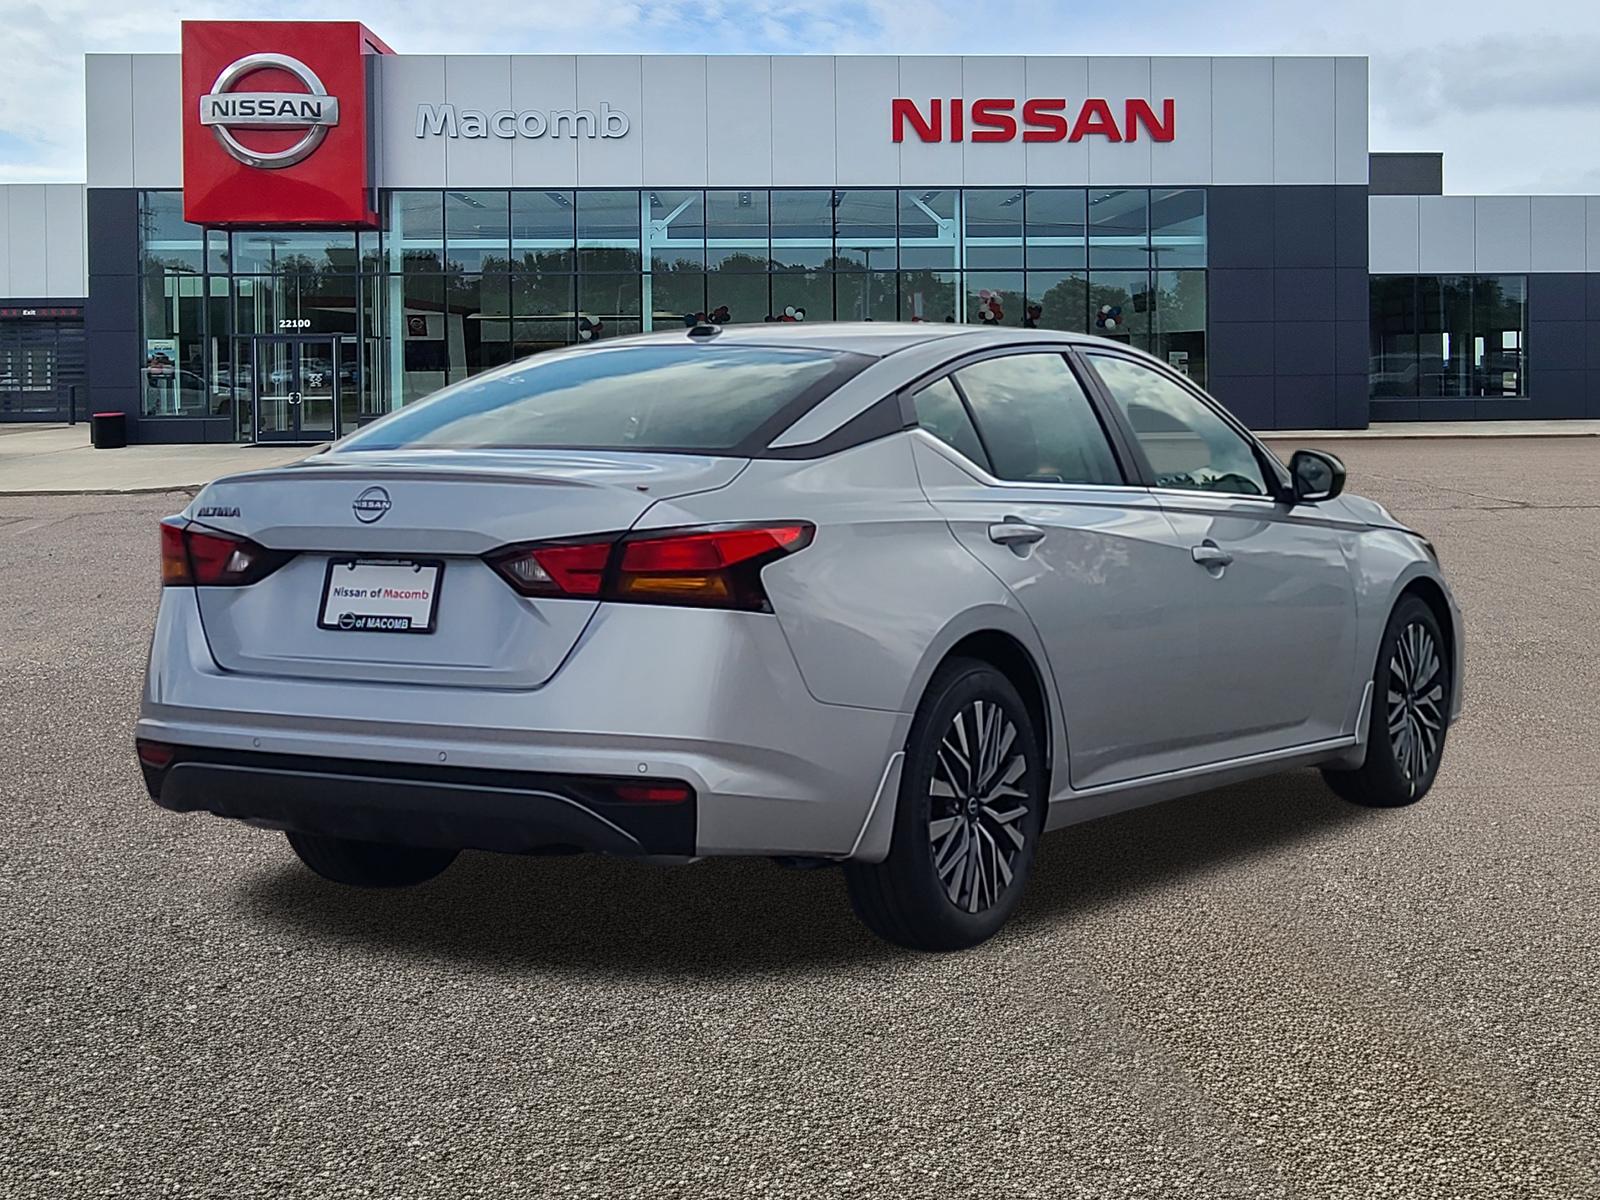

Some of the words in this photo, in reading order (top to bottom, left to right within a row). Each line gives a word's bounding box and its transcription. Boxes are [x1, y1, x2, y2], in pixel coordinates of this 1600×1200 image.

[211, 98, 322, 119] NISSAN
[415, 102, 631, 139] Macomb
[892, 98, 1176, 143] NISSAN
[279, 319, 311, 328] 22100
[353, 500, 391, 510] NISSAN
[333, 587, 367, 598] Nissan
[370, 588, 382, 598] of
[383, 589, 429, 600] Macomb
[355, 617, 366, 629] of
[366, 617, 409, 630] MACOMB
